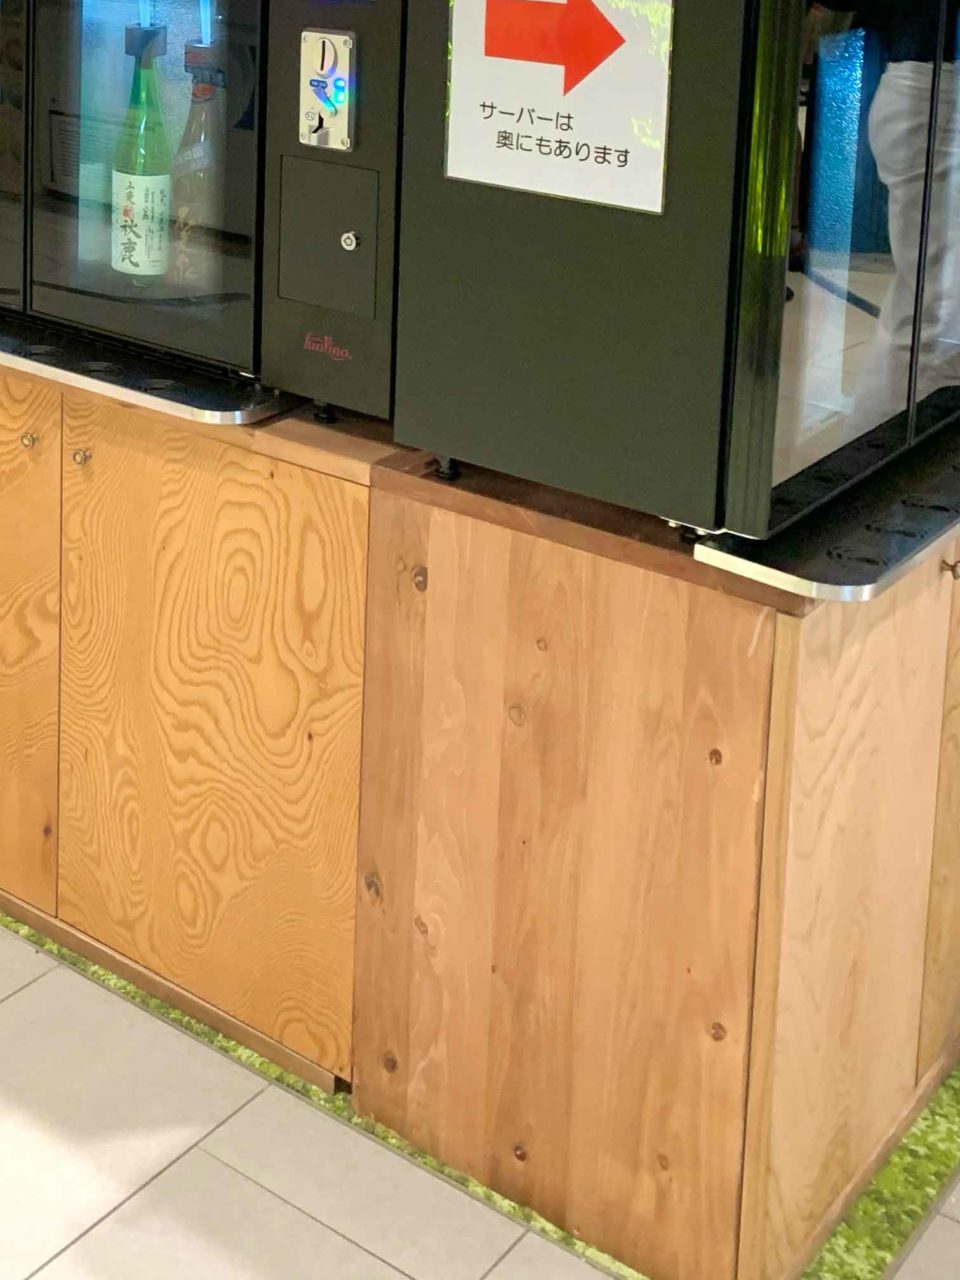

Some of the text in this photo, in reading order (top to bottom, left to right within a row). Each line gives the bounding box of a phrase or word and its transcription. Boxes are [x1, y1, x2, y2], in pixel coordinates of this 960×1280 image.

[480, 101, 574, 131] サーバーは
[496, 130, 631, 167] 奥にもあります
[120, 219, 143, 268] 秋鹿
